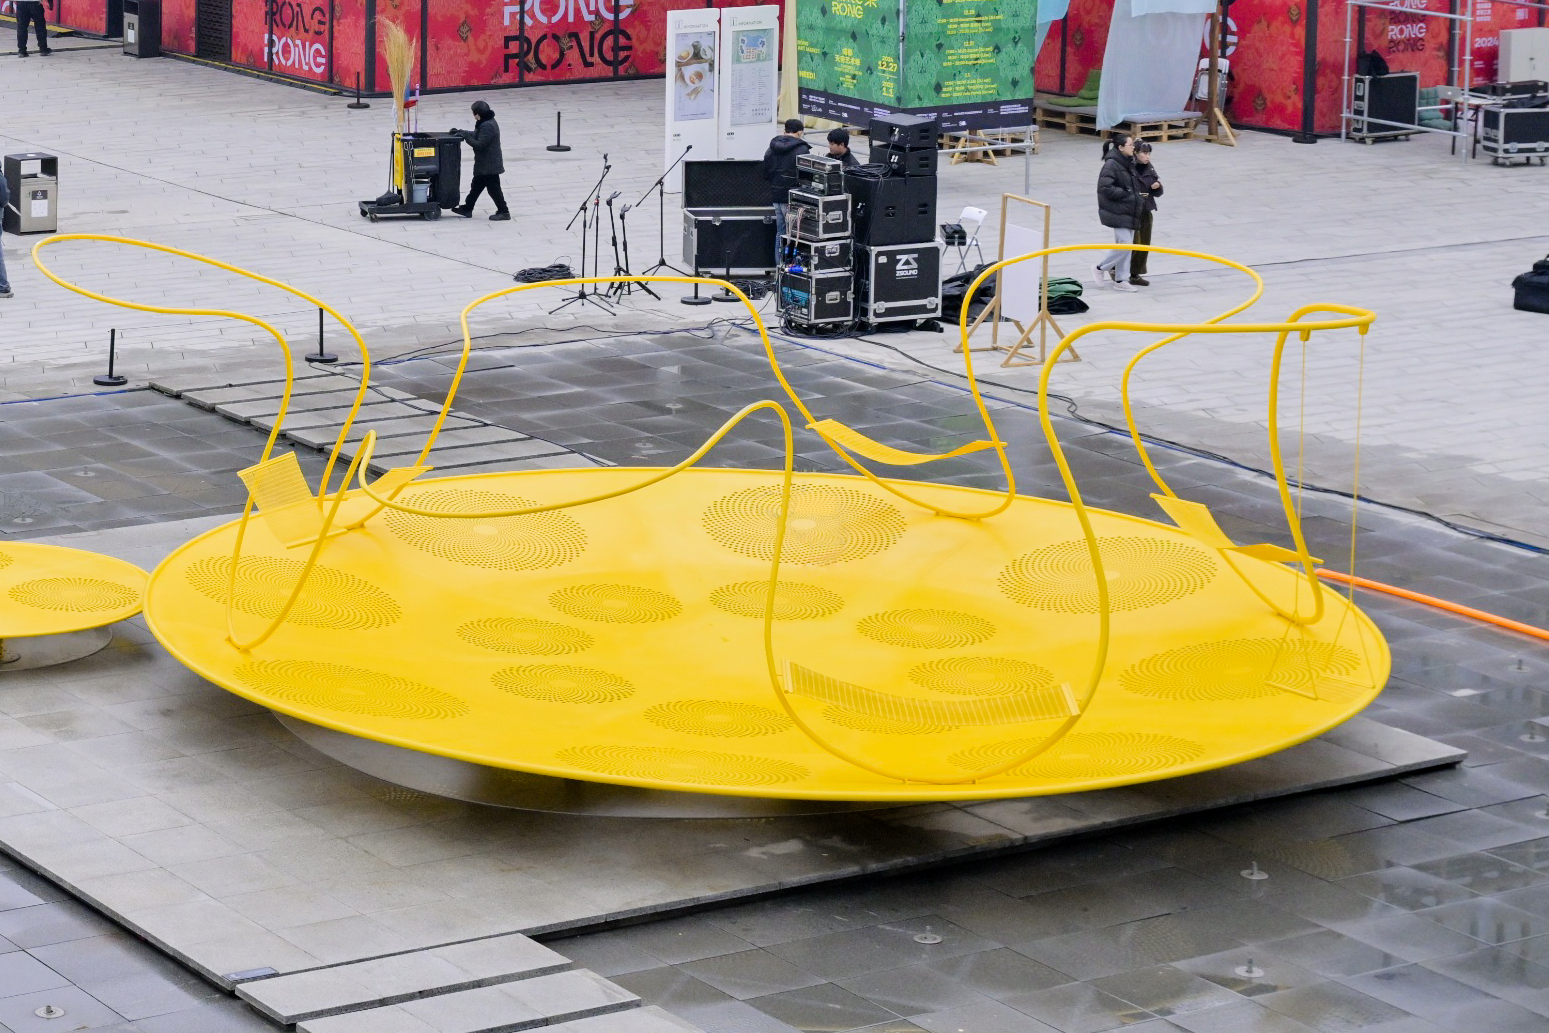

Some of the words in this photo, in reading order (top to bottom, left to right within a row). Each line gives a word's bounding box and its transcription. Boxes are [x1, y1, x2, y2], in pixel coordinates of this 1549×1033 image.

[832, 1, 863, 19] RONG
[1388, 23, 1426, 39] RONG
[503, 28, 633, 73] RONG
[1474, 37, 1499, 48] 2024
[264, 33, 326, 74] RONG
